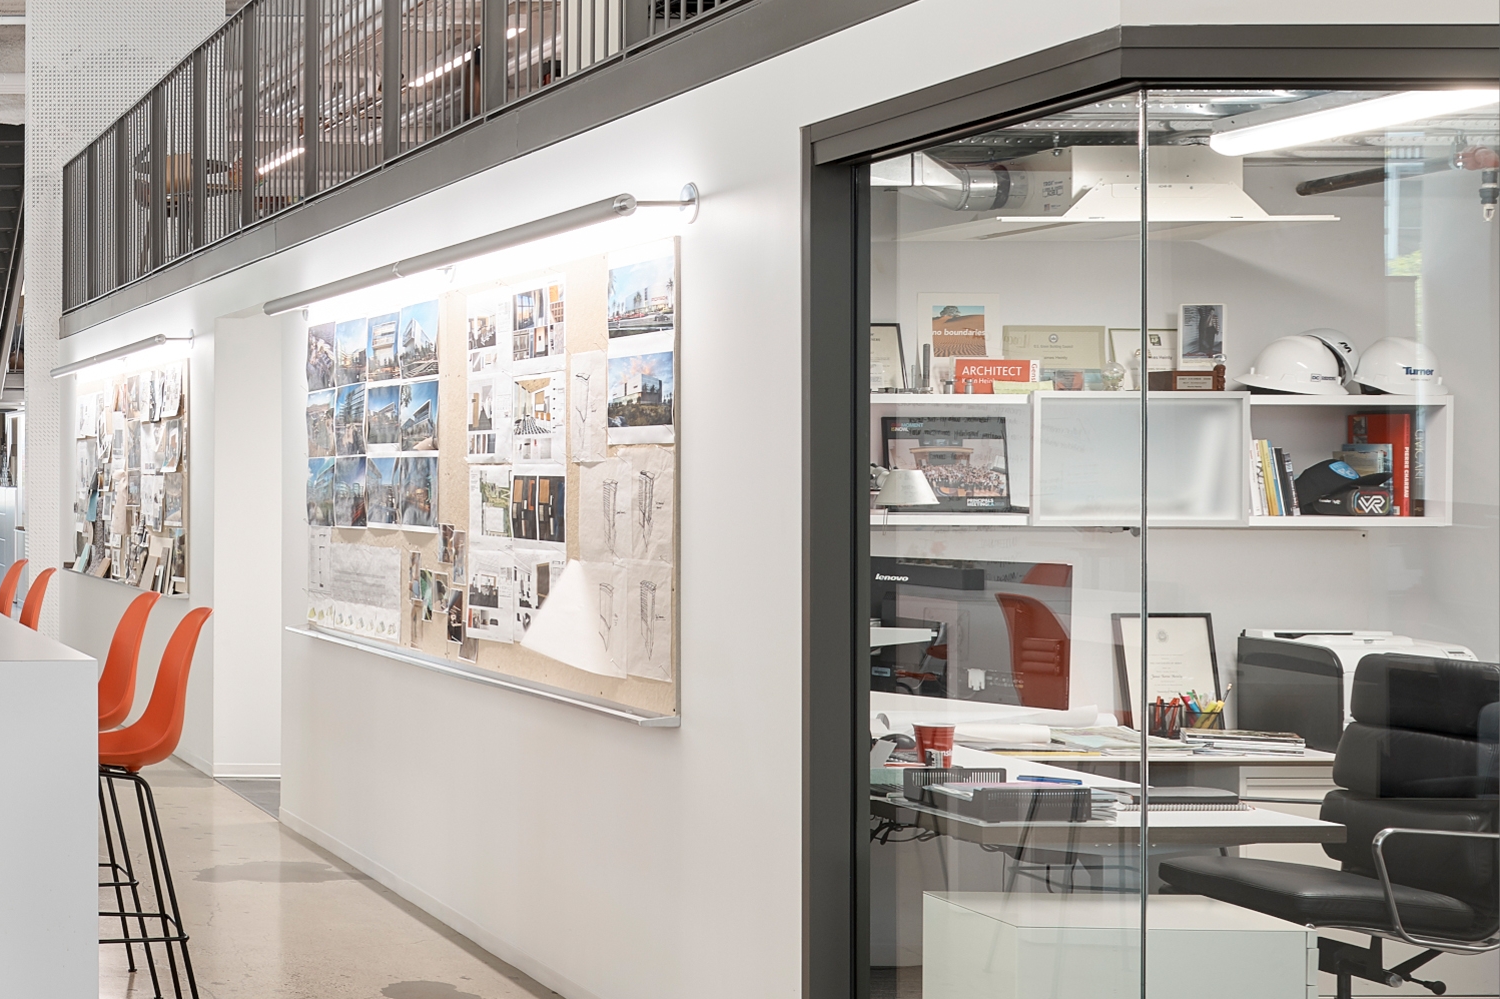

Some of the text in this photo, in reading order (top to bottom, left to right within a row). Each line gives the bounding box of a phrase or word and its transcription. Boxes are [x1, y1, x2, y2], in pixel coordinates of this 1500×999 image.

[944, 328, 986, 336] boundaries
[961, 365, 1023, 376] ARCHITECT
[1402, 366, 1434, 376] Turner
[1414, 461, 1424, 479] ART
[1358, 495, 1386, 514] VR
[875, 572, 909, 582] lenovo
